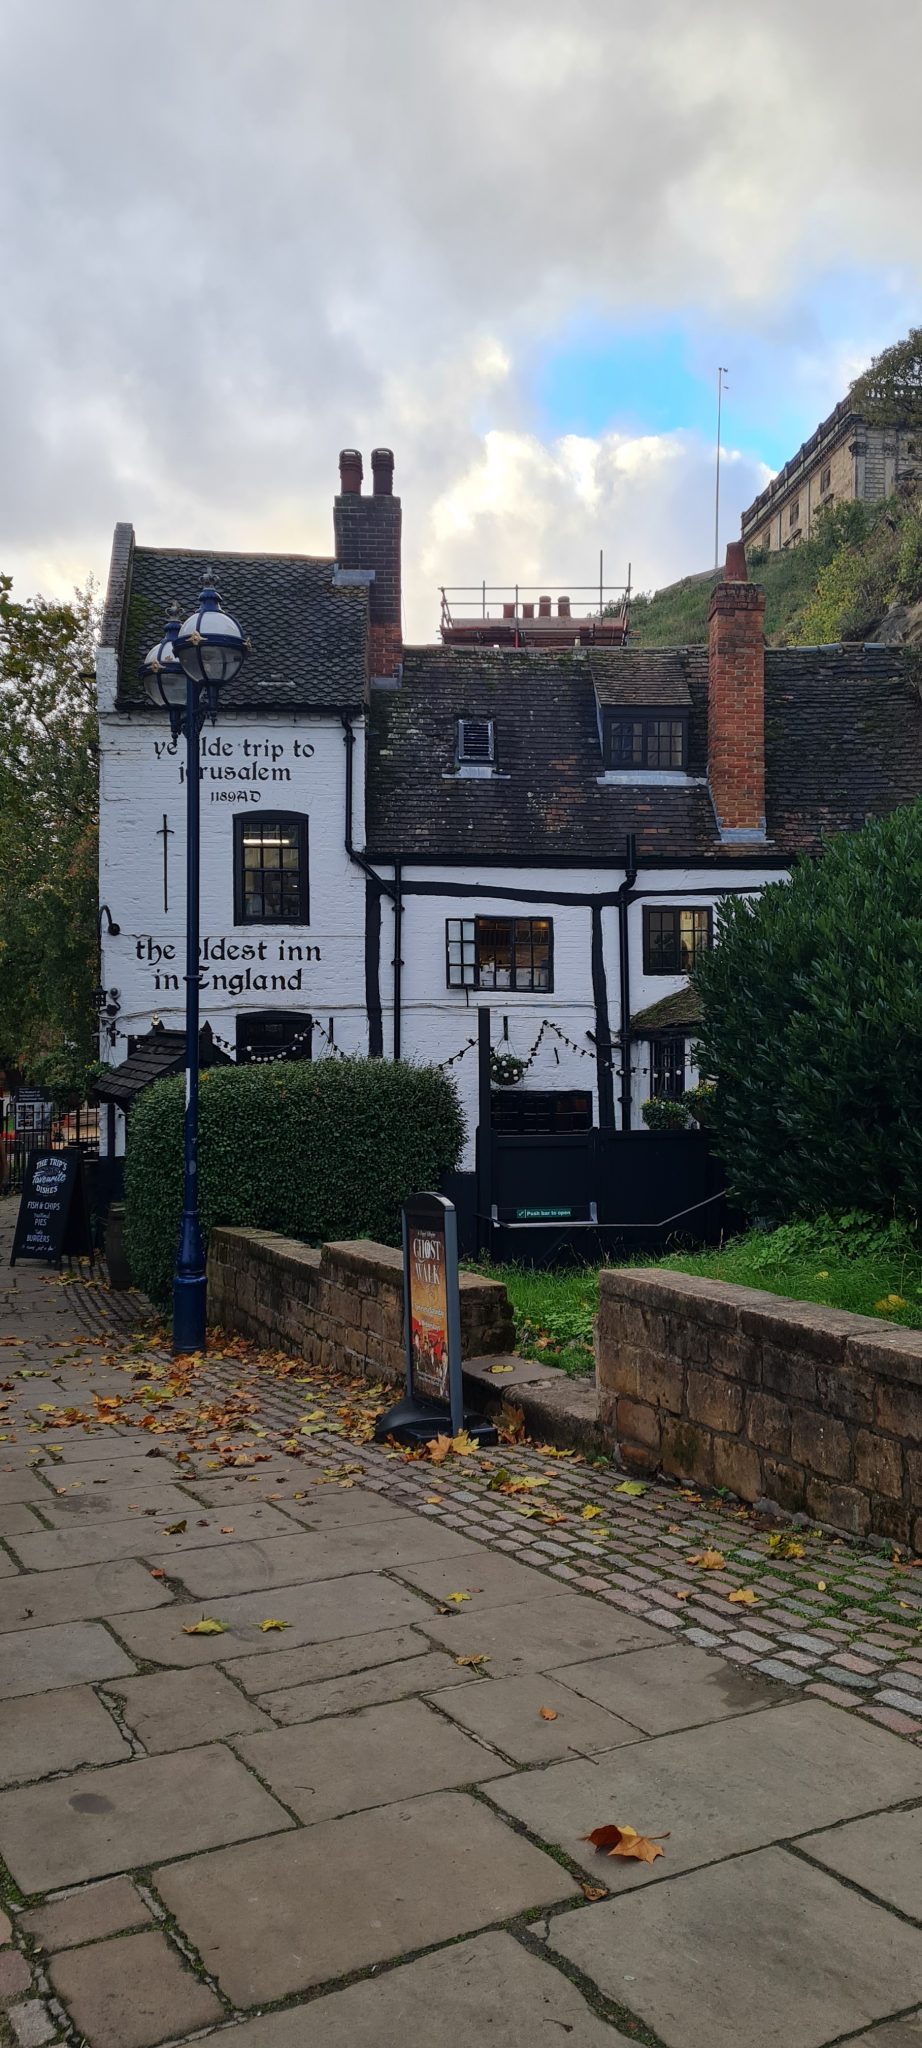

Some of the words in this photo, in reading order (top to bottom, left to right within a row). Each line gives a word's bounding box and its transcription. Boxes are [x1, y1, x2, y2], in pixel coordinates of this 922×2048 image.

[153, 740, 178, 760] ye
[197, 736, 234, 757] lde
[243, 738, 284, 762] trip
[293, 739, 315, 758] to
[178, 761, 292, 784] jrusalem
[135, 937, 176, 966] the
[196, 936, 268, 961] ldest
[278, 939, 322, 962] inn
[154, 968, 180, 990] in
[36, 1159, 49, 1170] THE
[49, 1158, 67, 1171] TRIP'S
[35, 1184, 58, 1194] DISHES
[27, 1201, 39, 1210] FISH
[44, 1202, 60, 1211] CHIPS
[34, 1218, 47, 1227] PIES
[26, 1234, 50, 1243] BURGERS
[413, 1238, 441, 1261] GHOST
[415, 1263, 441, 1285] WALK
